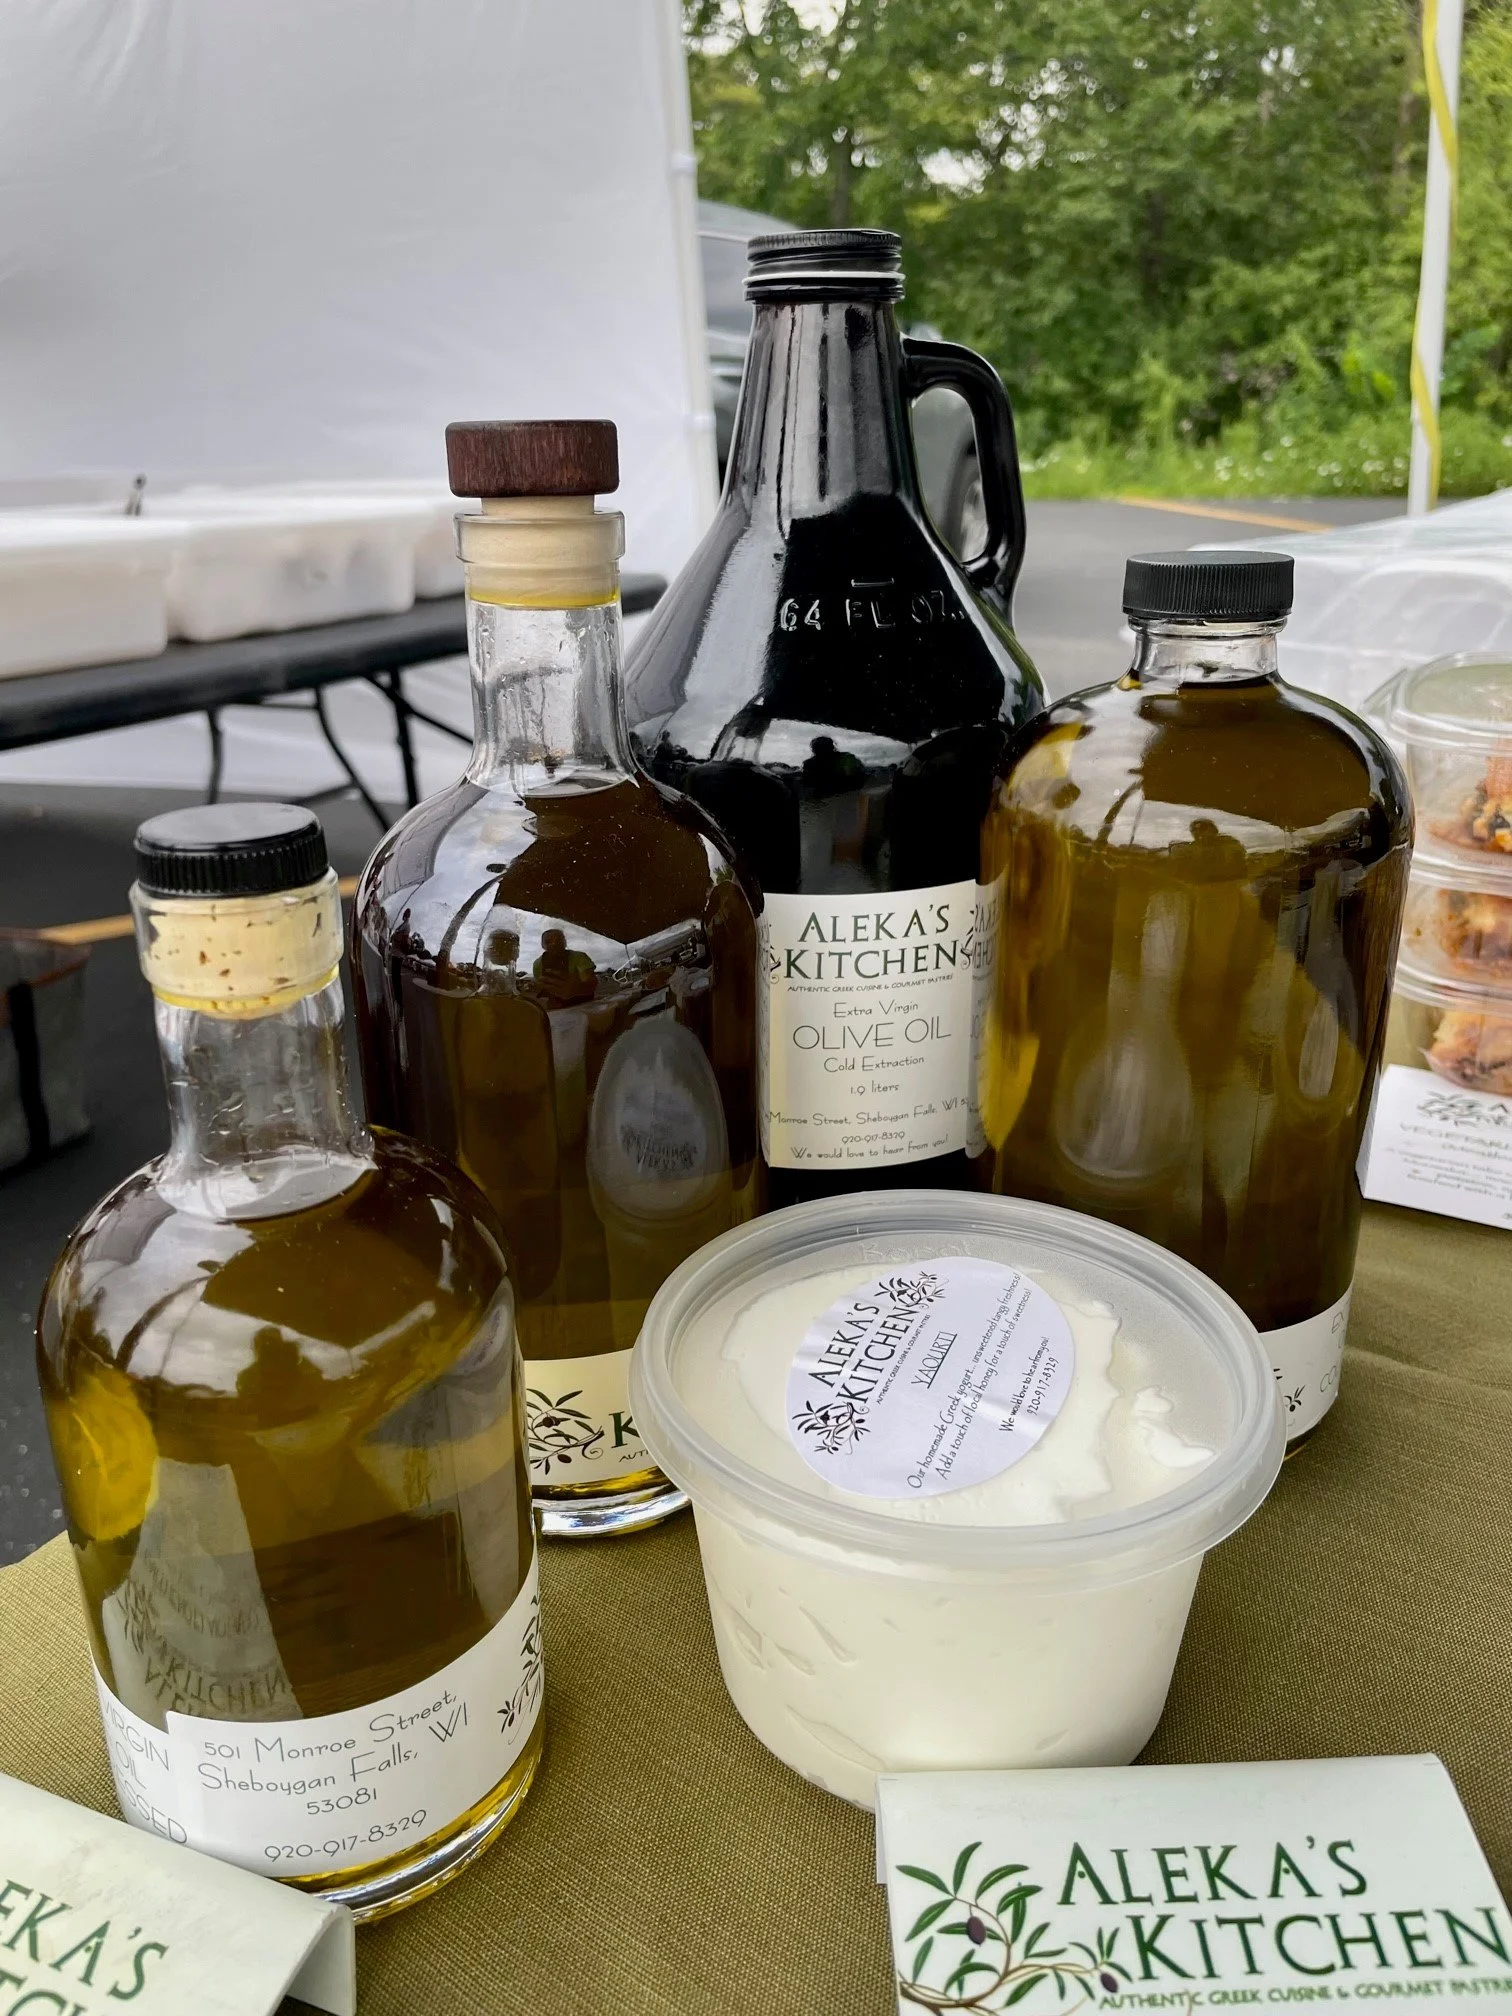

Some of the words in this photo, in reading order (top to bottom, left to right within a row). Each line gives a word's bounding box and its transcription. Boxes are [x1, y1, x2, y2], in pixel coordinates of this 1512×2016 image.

[780, 598, 823, 631] 64
[845, 598, 896, 629] FL
[798, 904, 950, 943] ALEKA'S
[784, 939, 959, 980] KITCHEN
[787, 985, 830, 993] AUTHENTIC
[833, 1002, 873, 1018] Extra
[878, 999, 919, 1015] Virgin
[793, 1022, 895, 1050] OLIVE
[904, 1016, 952, 1043] OIL
[823, 1056, 856, 1073] Cold
[861, 1055, 925, 1072] Extraction
[850, 1086, 866, 1096] 1.9
[871, 1080, 900, 1093] liters
[856, 1111, 909, 1125] Sheboygan
[942, 1097, 958, 1111] WI
[790, 1146, 812, 1159] We
[817, 1147, 842, 1158] would
[847, 1147, 865, 1158] love
[869, 1148, 879, 1157] to
[908, 1140, 928, 1154] from
[841, 1130, 906, 1144] 920-917-8329
[992, 1304, 1010, 1322] tangy
[1005, 1318, 1017, 1330] of
[808, 1302, 880, 1388] ALEKA'S
[972, 1318, 998, 1364] unsweetened
[996, 1329, 1012, 1349] touch
[836, 1305, 919, 1403] KITCHEN
[911, 1331, 957, 1388] YAOURTI
[984, 1354, 1000, 1368] for
[977, 1367, 999, 1392] honey
[1013, 1384, 1029, 1399] love
[1026, 1357, 1059, 1416] 920-917-8329
[939, 1395, 961, 1424] Greek
[963, 1388, 983, 1413] local
[1010, 1397, 1022, 1416] would
[961, 1409, 974, 1424] of
[999, 1417, 1015, 1432] We
[916, 1424, 948, 1469] homemade
[950, 1423, 969, 1450] touch
[907, 1467, 926, 1488] Our
[935, 1453, 954, 1480] Add
[203, 1741, 241, 1760] 501
[255, 1737, 357, 1763] Monroe
[368, 1689, 457, 1744] Street,
[198, 1762, 336, 1795] Sheboygan
[349, 1742, 419, 1782] Falls,
[428, 1701, 469, 1744] WI
[115, 1741, 147, 1790] OIL
[116, 1763, 188, 1844] ESSED
[307, 1787, 378, 1816] 53081
[263, 1809, 427, 1862] 920-917-8329
[1057, 1835, 1369, 1906] ALEKA'S
[0, 1879, 169, 2000] EKA'S
[1125, 1906, 1512, 1982] KITCHEN
[1099, 1989, 1202, 2010] AUTHENTIC
[1207, 1988, 1261, 2006] GREEK
[1267, 1985, 1333, 2003] CUISINE
[1354, 1979, 1443, 1998] GOURMET
